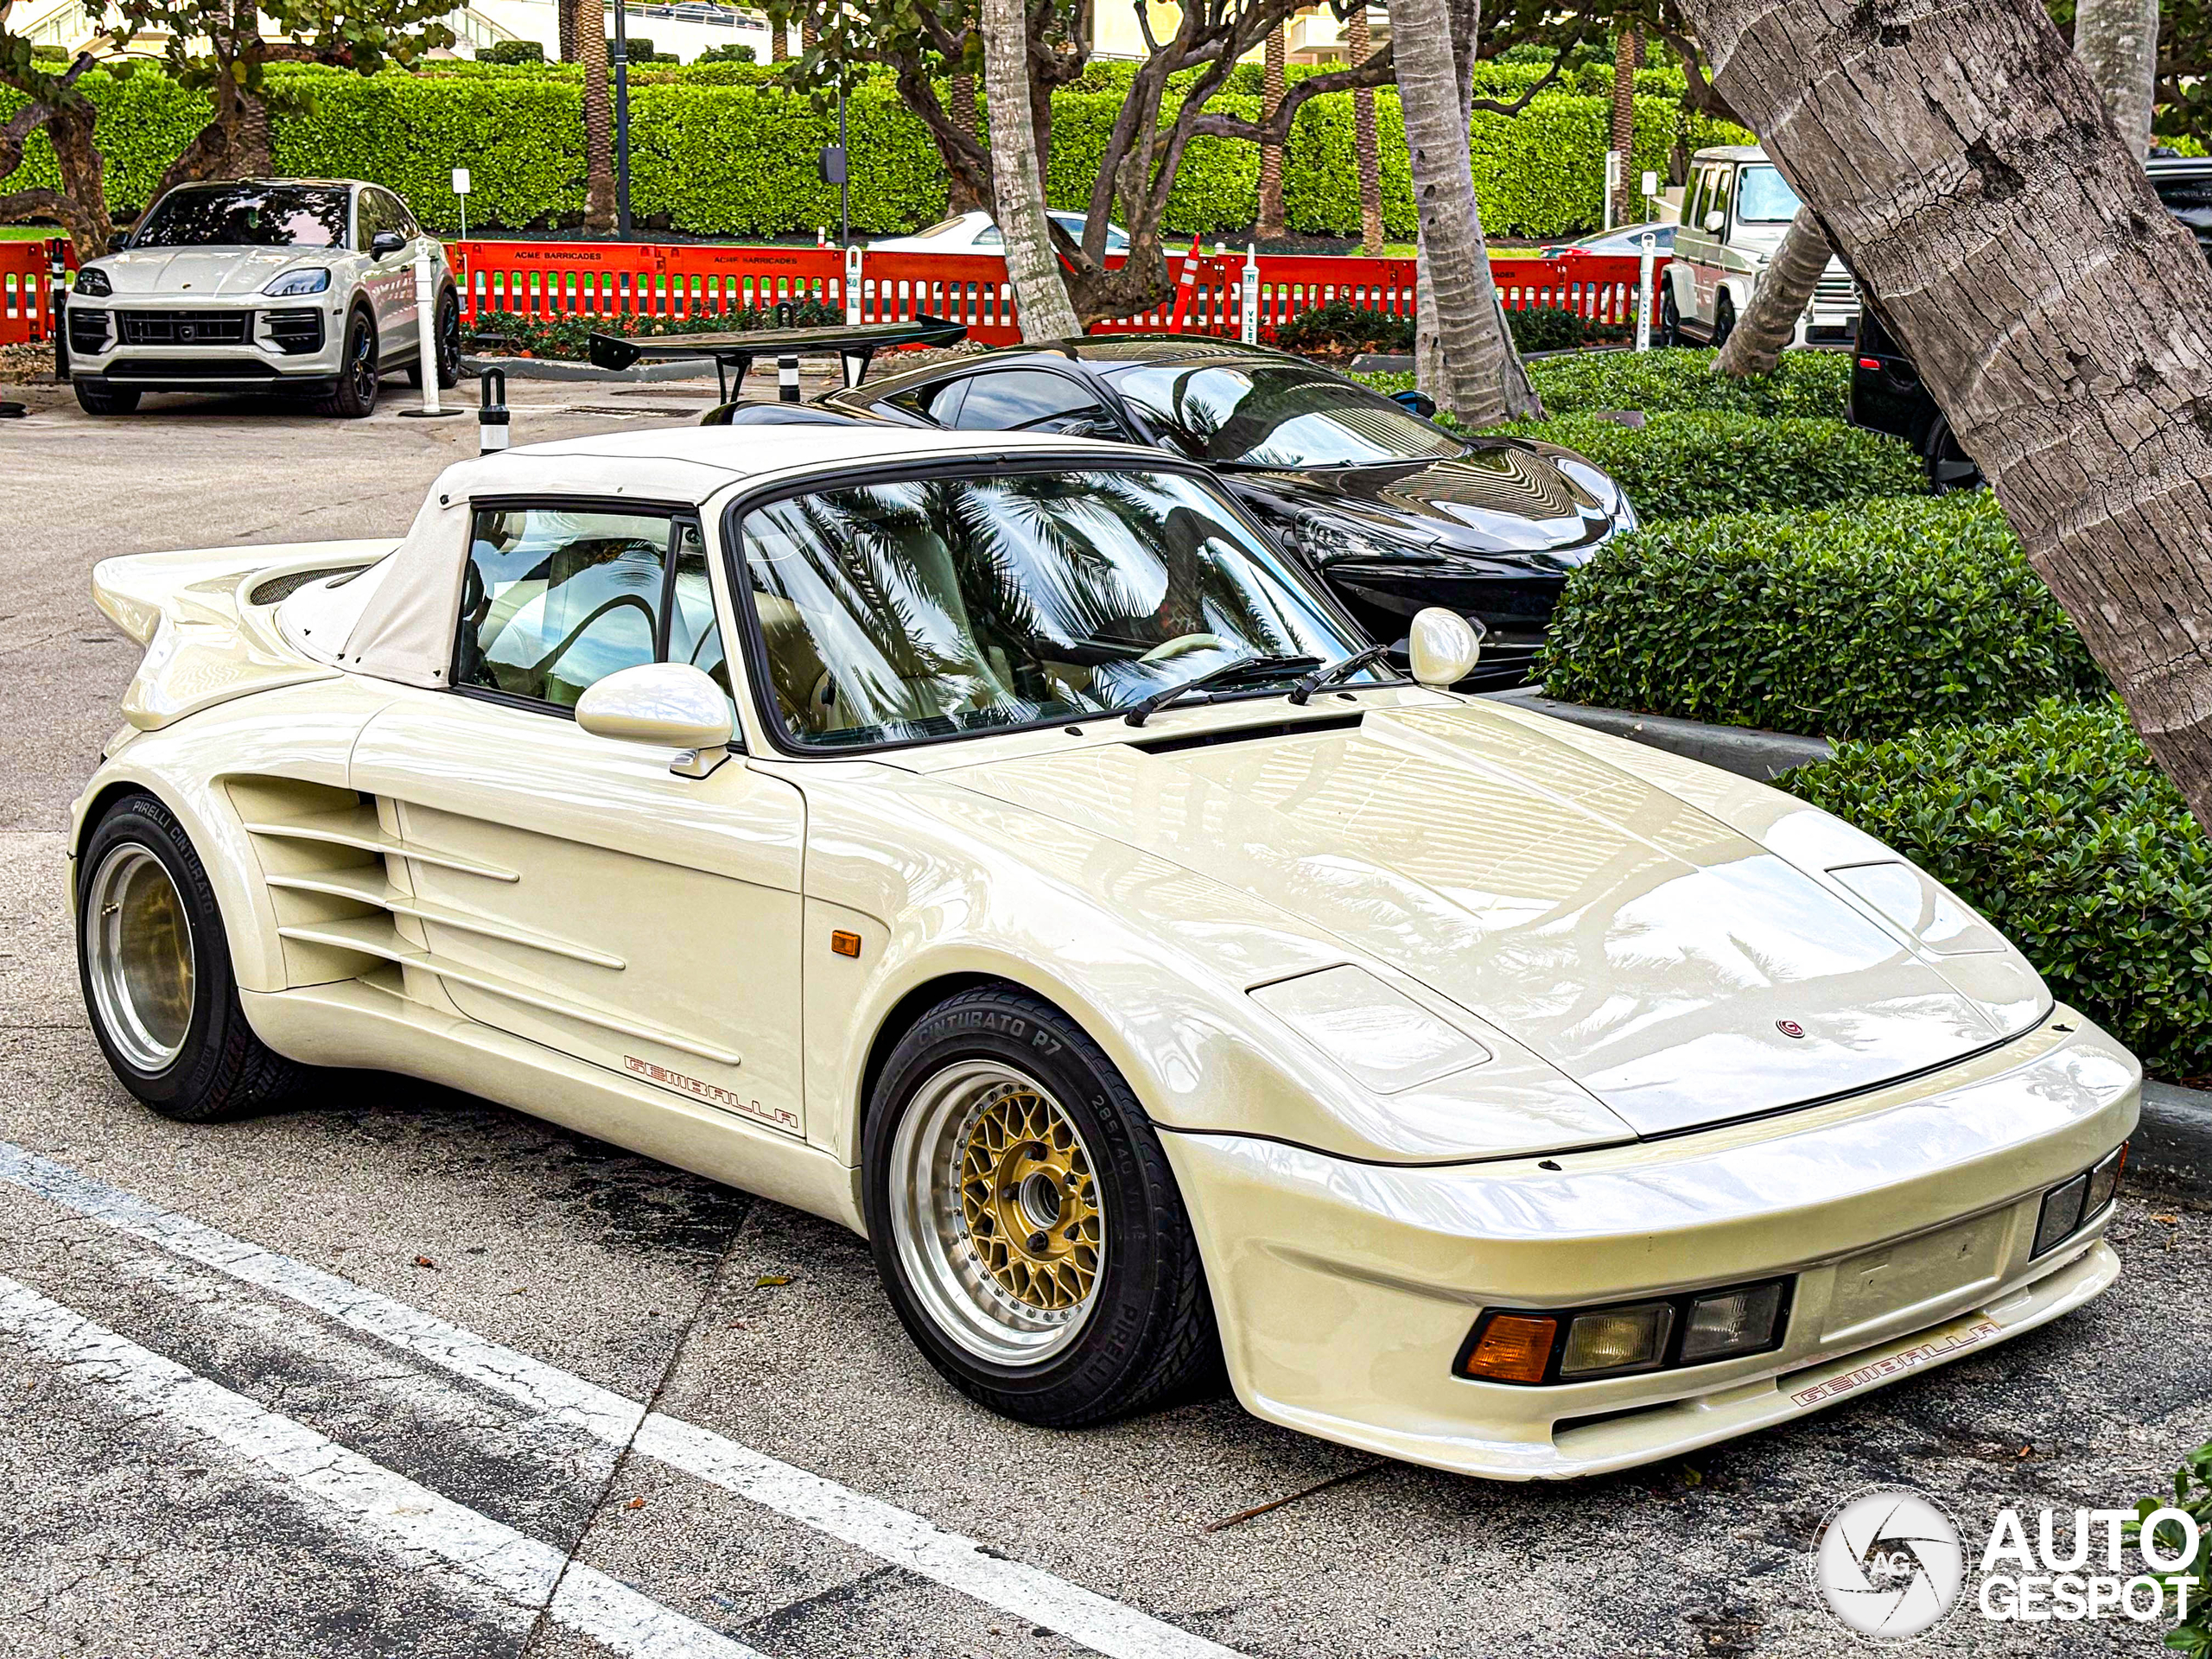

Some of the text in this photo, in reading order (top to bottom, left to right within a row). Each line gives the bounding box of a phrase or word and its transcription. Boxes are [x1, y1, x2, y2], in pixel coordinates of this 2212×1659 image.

[132, 800, 172, 829] PIRELLI
[168, 826, 214, 915] CINTURATO
[918, 1009, 1064, 1058] CINTURATO P7
[624, 1054, 798, 1129] GEMBALLA
[1090, 1093, 1135, 1176] 285/40
[1083, 1303, 1139, 1387] PIRELLI
[1790, 1321, 2002, 1408] GEMBALLA
